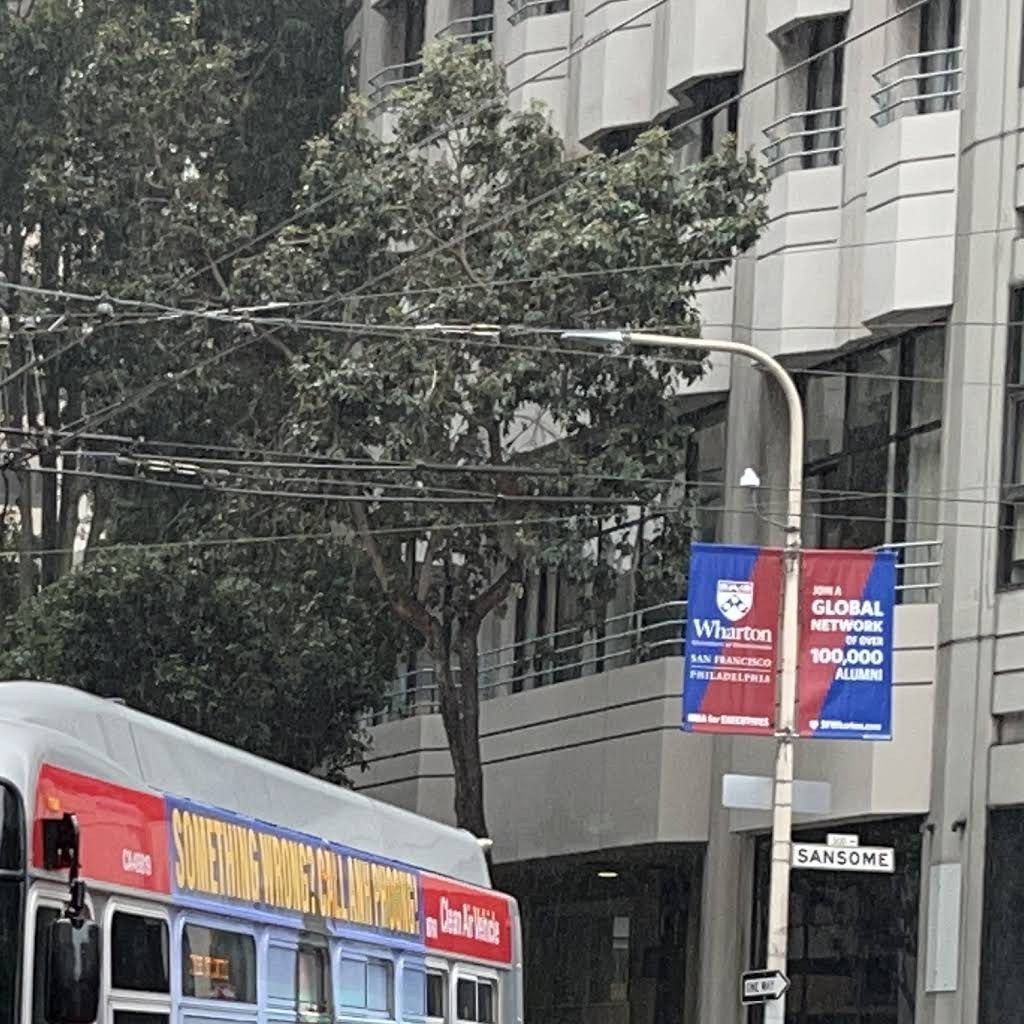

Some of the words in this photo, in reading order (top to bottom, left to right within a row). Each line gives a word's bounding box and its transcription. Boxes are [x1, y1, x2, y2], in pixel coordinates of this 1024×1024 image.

[834, 586, 842, 596] A
[811, 599, 884, 617] GLOBAL
[693, 618, 772, 643] Wharton
[810, 618, 883, 632] NETWORK
[845, 635, 857, 646] OF
[859, 635, 883, 646] OVER
[690, 654, 712, 664] SAN
[714, 655, 772, 667] FRANCISCO
[810, 648, 883, 666] 100,000
[689, 670, 770, 683] PHILADELPHIA
[835, 667, 883, 681] ALUMNI
[171, 807, 260, 902] SOMETHING
[259, 830, 316, 915] WRONG?
[798, 848, 889, 867] SANSOME
